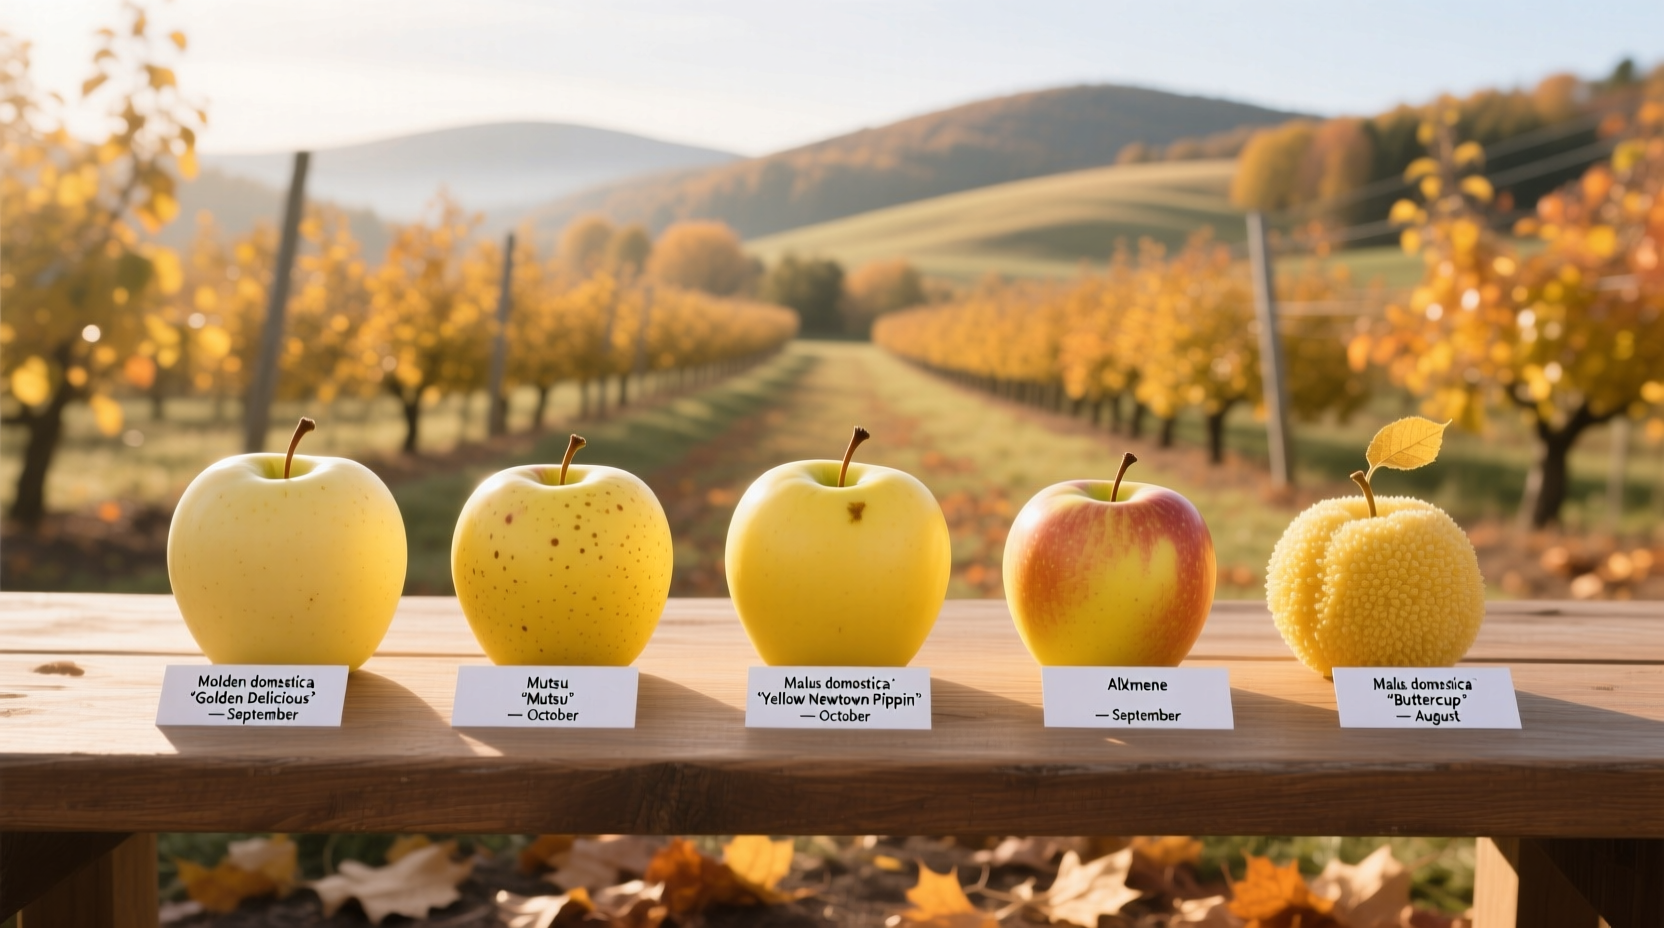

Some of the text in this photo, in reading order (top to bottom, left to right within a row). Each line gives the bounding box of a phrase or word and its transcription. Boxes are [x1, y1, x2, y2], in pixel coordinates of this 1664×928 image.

[198, 674, 247, 689] Molden
[526, 676, 569, 690] Mutsu
[784, 676, 822, 690] Malus
[808, 692, 870, 706] Newtown
[527, 708, 580, 722] October
[819, 709, 871, 723] October
[1112, 708, 1182, 725] September
[1415, 709, 1461, 726] August
